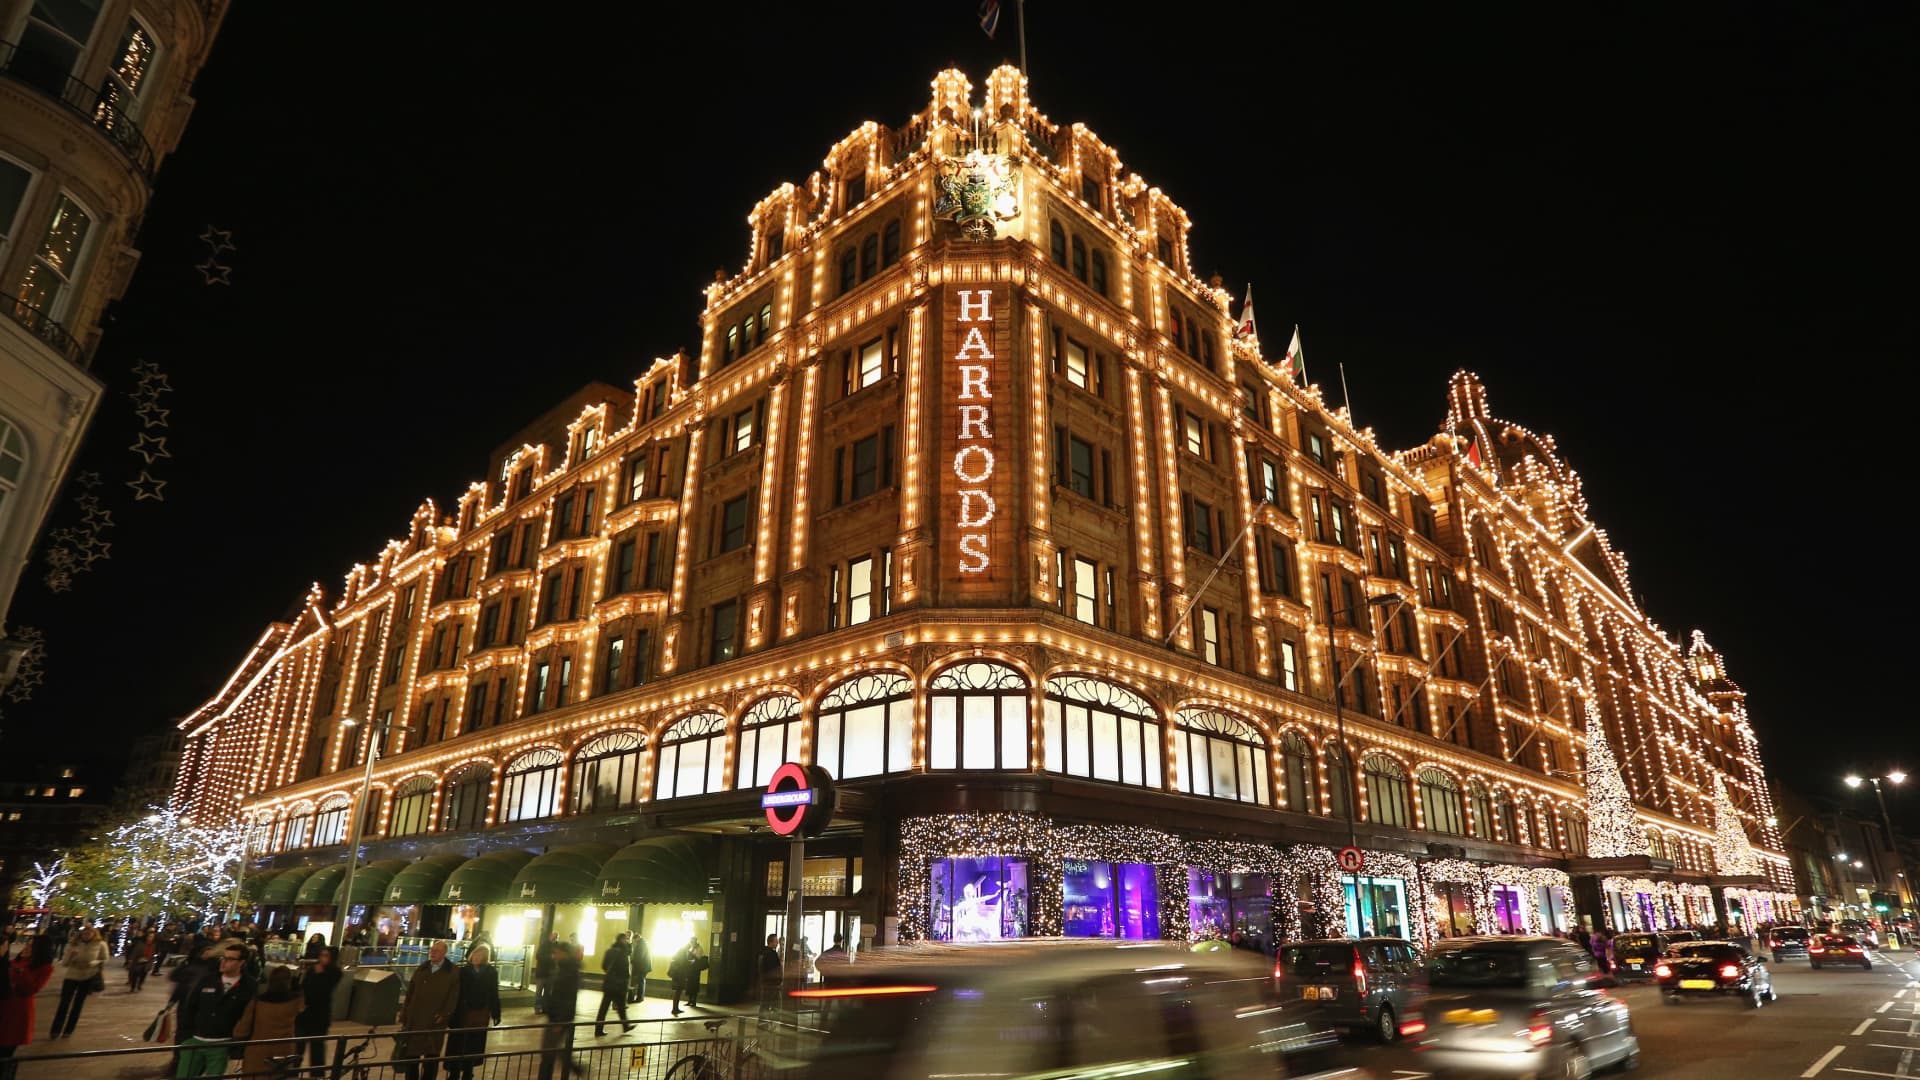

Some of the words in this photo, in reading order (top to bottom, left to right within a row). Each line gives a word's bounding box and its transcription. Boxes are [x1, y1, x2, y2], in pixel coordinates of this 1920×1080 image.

[953, 289, 996, 573] HARRODS
[764, 792, 810, 805] UNDERGROUND
[631, 1047, 645, 1067] H
